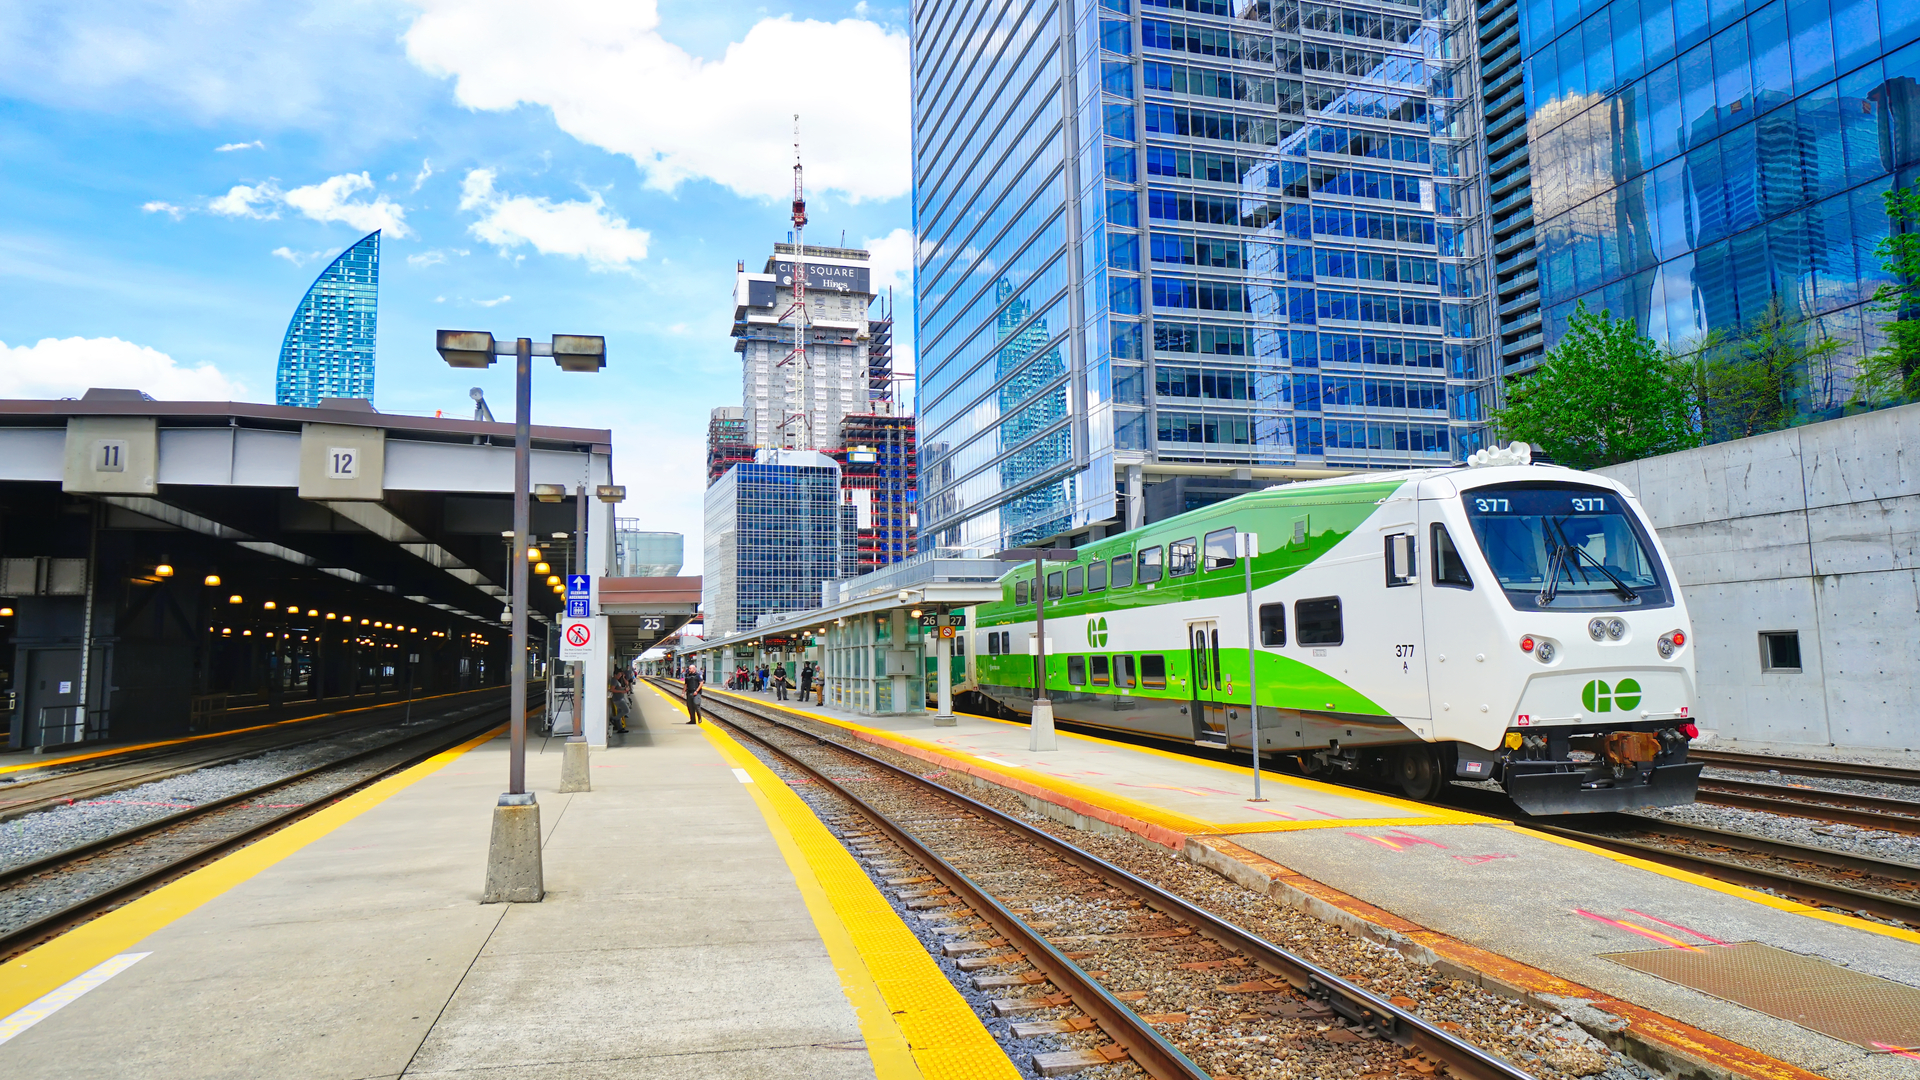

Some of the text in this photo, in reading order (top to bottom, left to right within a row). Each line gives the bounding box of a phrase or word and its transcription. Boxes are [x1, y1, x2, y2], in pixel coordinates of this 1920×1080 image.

[779, 263, 854, 277] CI SQUARE
[822, 278, 848, 289] Hines
[103, 445, 119, 466] 11
[333, 453, 352, 474] 12
[1475, 498, 1509, 512] 377
[1571, 498, 1604, 511] 377
[643, 618, 661, 630] 25
[923, 616, 936, 625] 26
[950, 616, 962, 625] 27
[1395, 644, 1414, 657] 377
[1403, 661, 1408, 670] A
